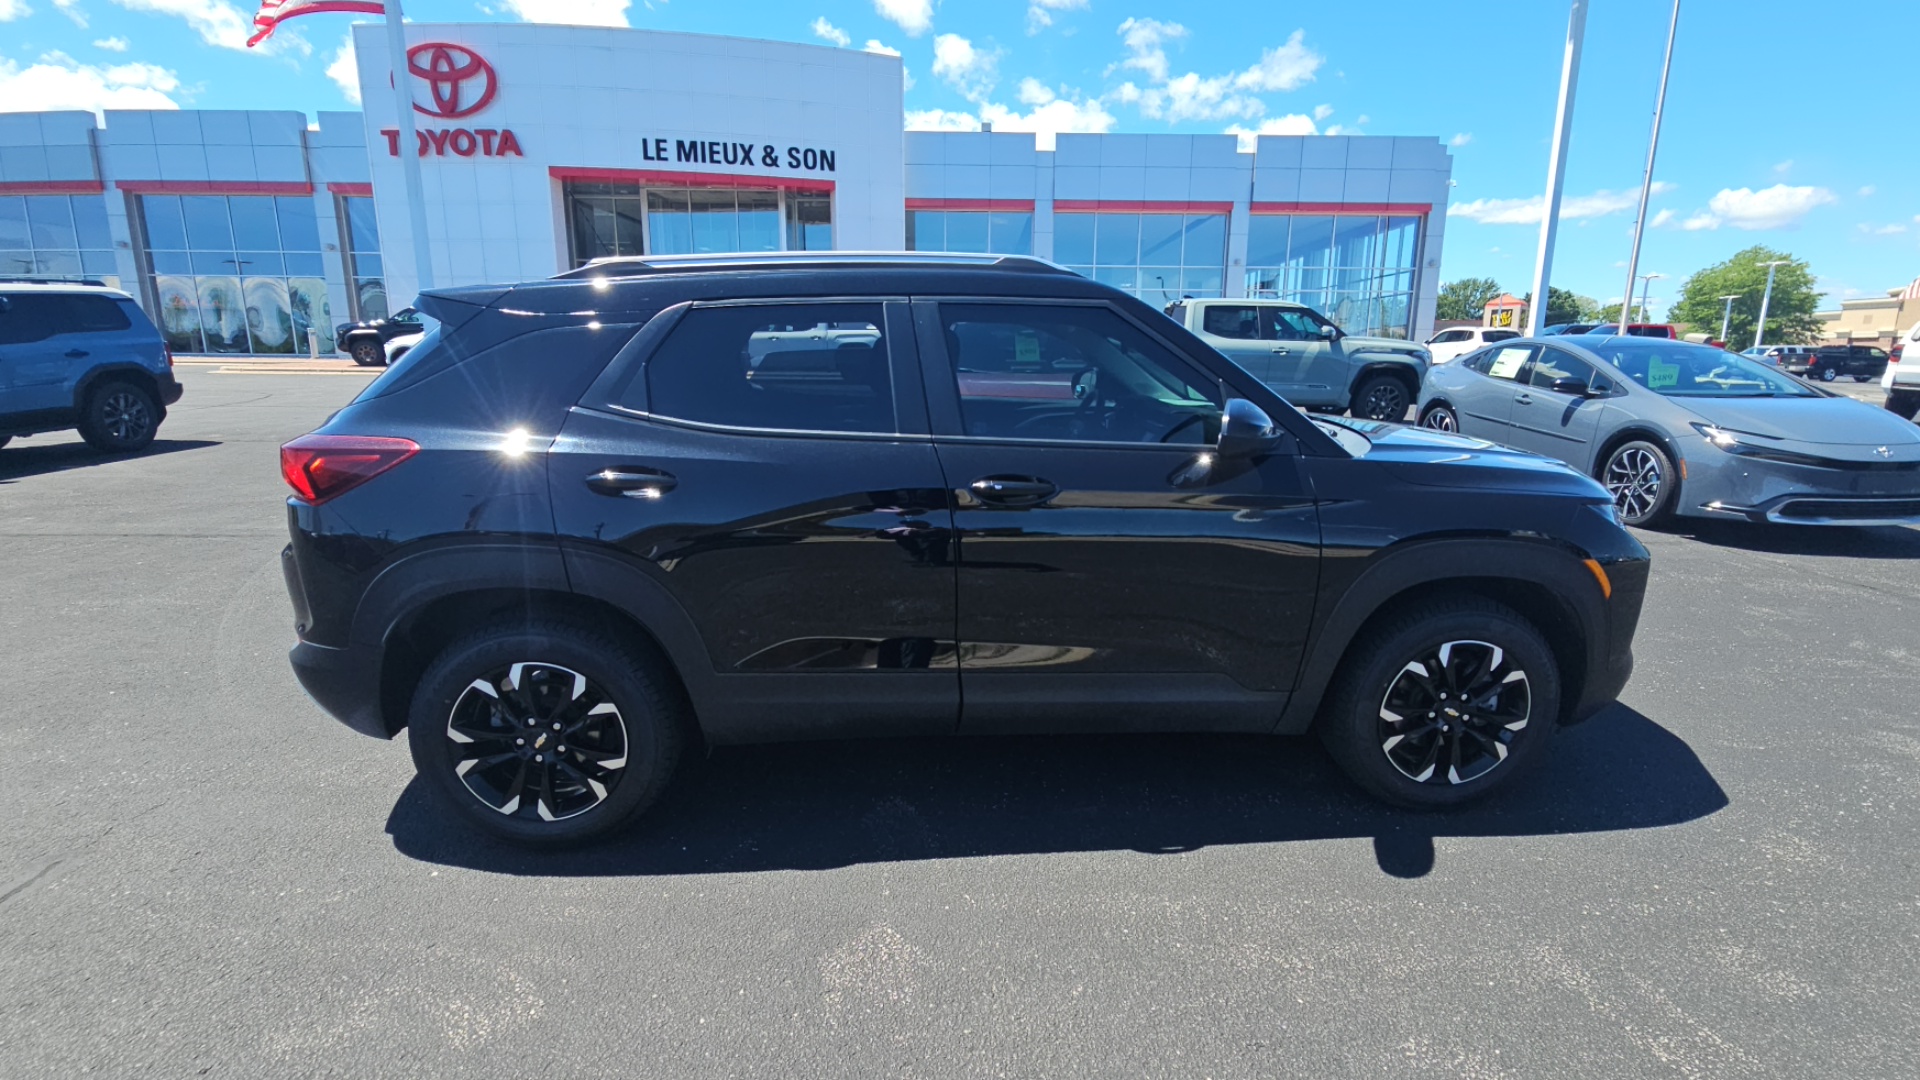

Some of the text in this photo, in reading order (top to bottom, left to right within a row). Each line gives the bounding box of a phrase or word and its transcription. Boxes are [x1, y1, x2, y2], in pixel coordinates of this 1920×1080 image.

[642, 138, 836, 172] LE MIEUX & SON
